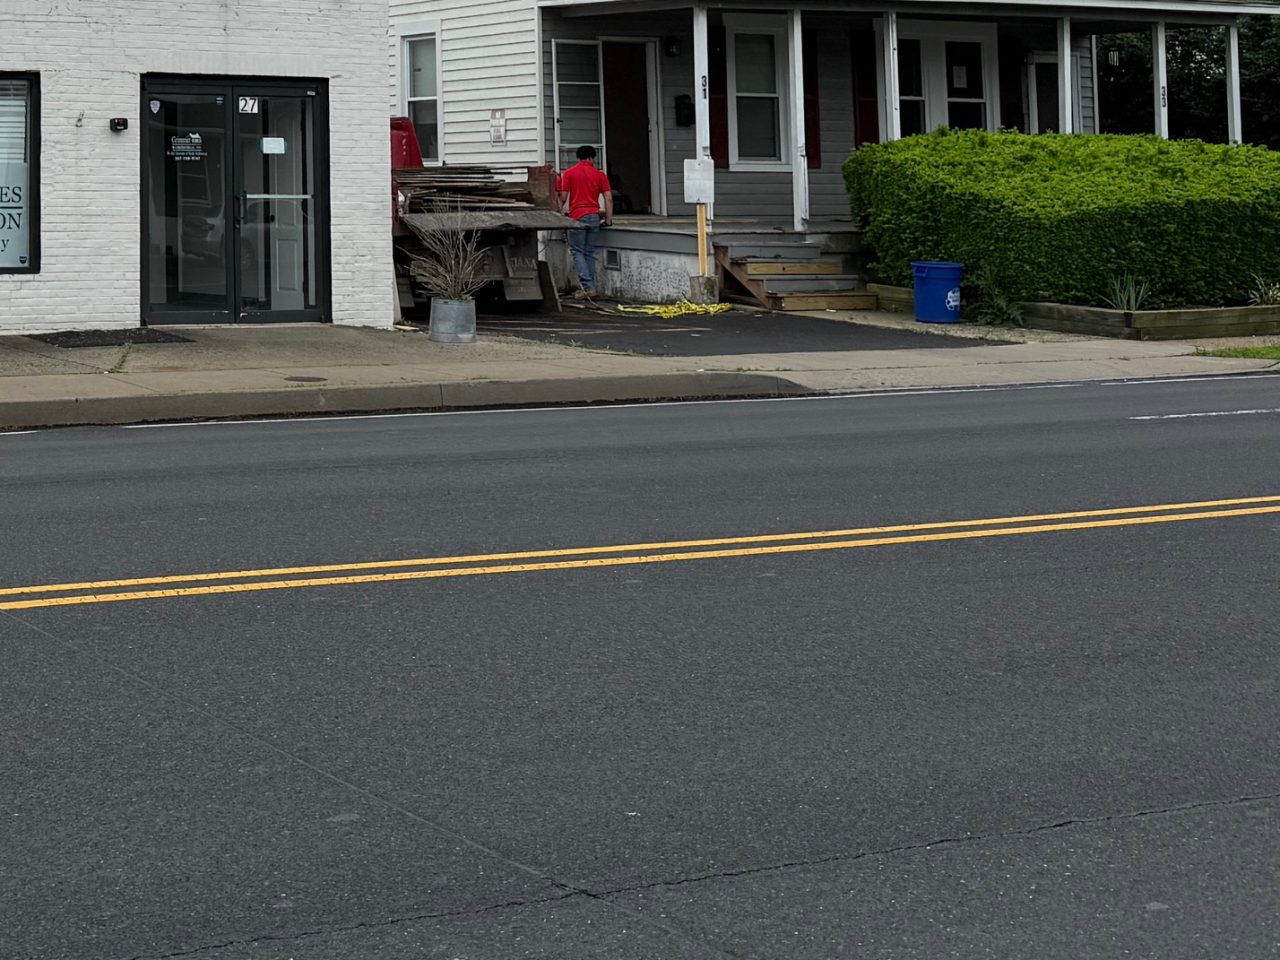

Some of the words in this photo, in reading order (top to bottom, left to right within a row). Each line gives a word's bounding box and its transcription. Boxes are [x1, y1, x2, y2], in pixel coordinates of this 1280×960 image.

[701, 75, 708, 100] 31
[1161, 85, 1167, 108] 33
[239, 97, 257, 112] 27
